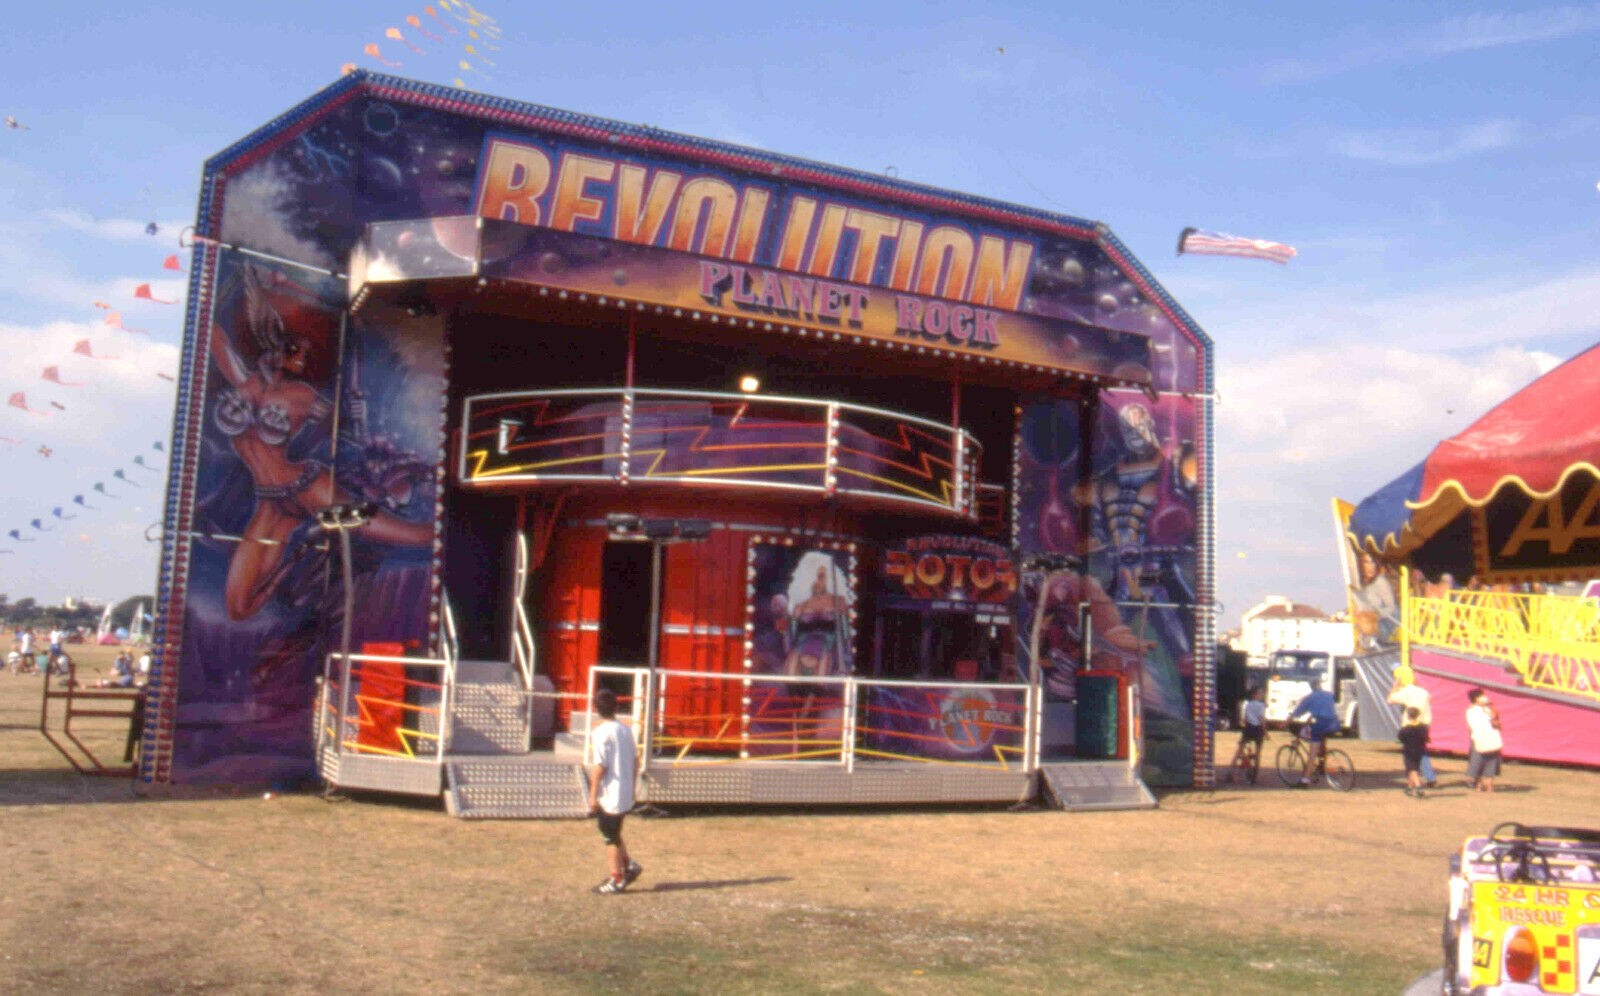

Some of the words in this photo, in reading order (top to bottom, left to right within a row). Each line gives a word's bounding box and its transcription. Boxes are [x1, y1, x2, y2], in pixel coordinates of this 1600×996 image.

[477, 140, 1035, 311] REVOLUTION
[699, 259, 870, 325] PLANET
[896, 293, 1002, 347] ROCK
[886, 551, 1018, 591] ROTOR
[1494, 885, 1527, 902] 24
[1534, 887, 1571, 907] HR
[1499, 905, 1566, 927] RESCUE
